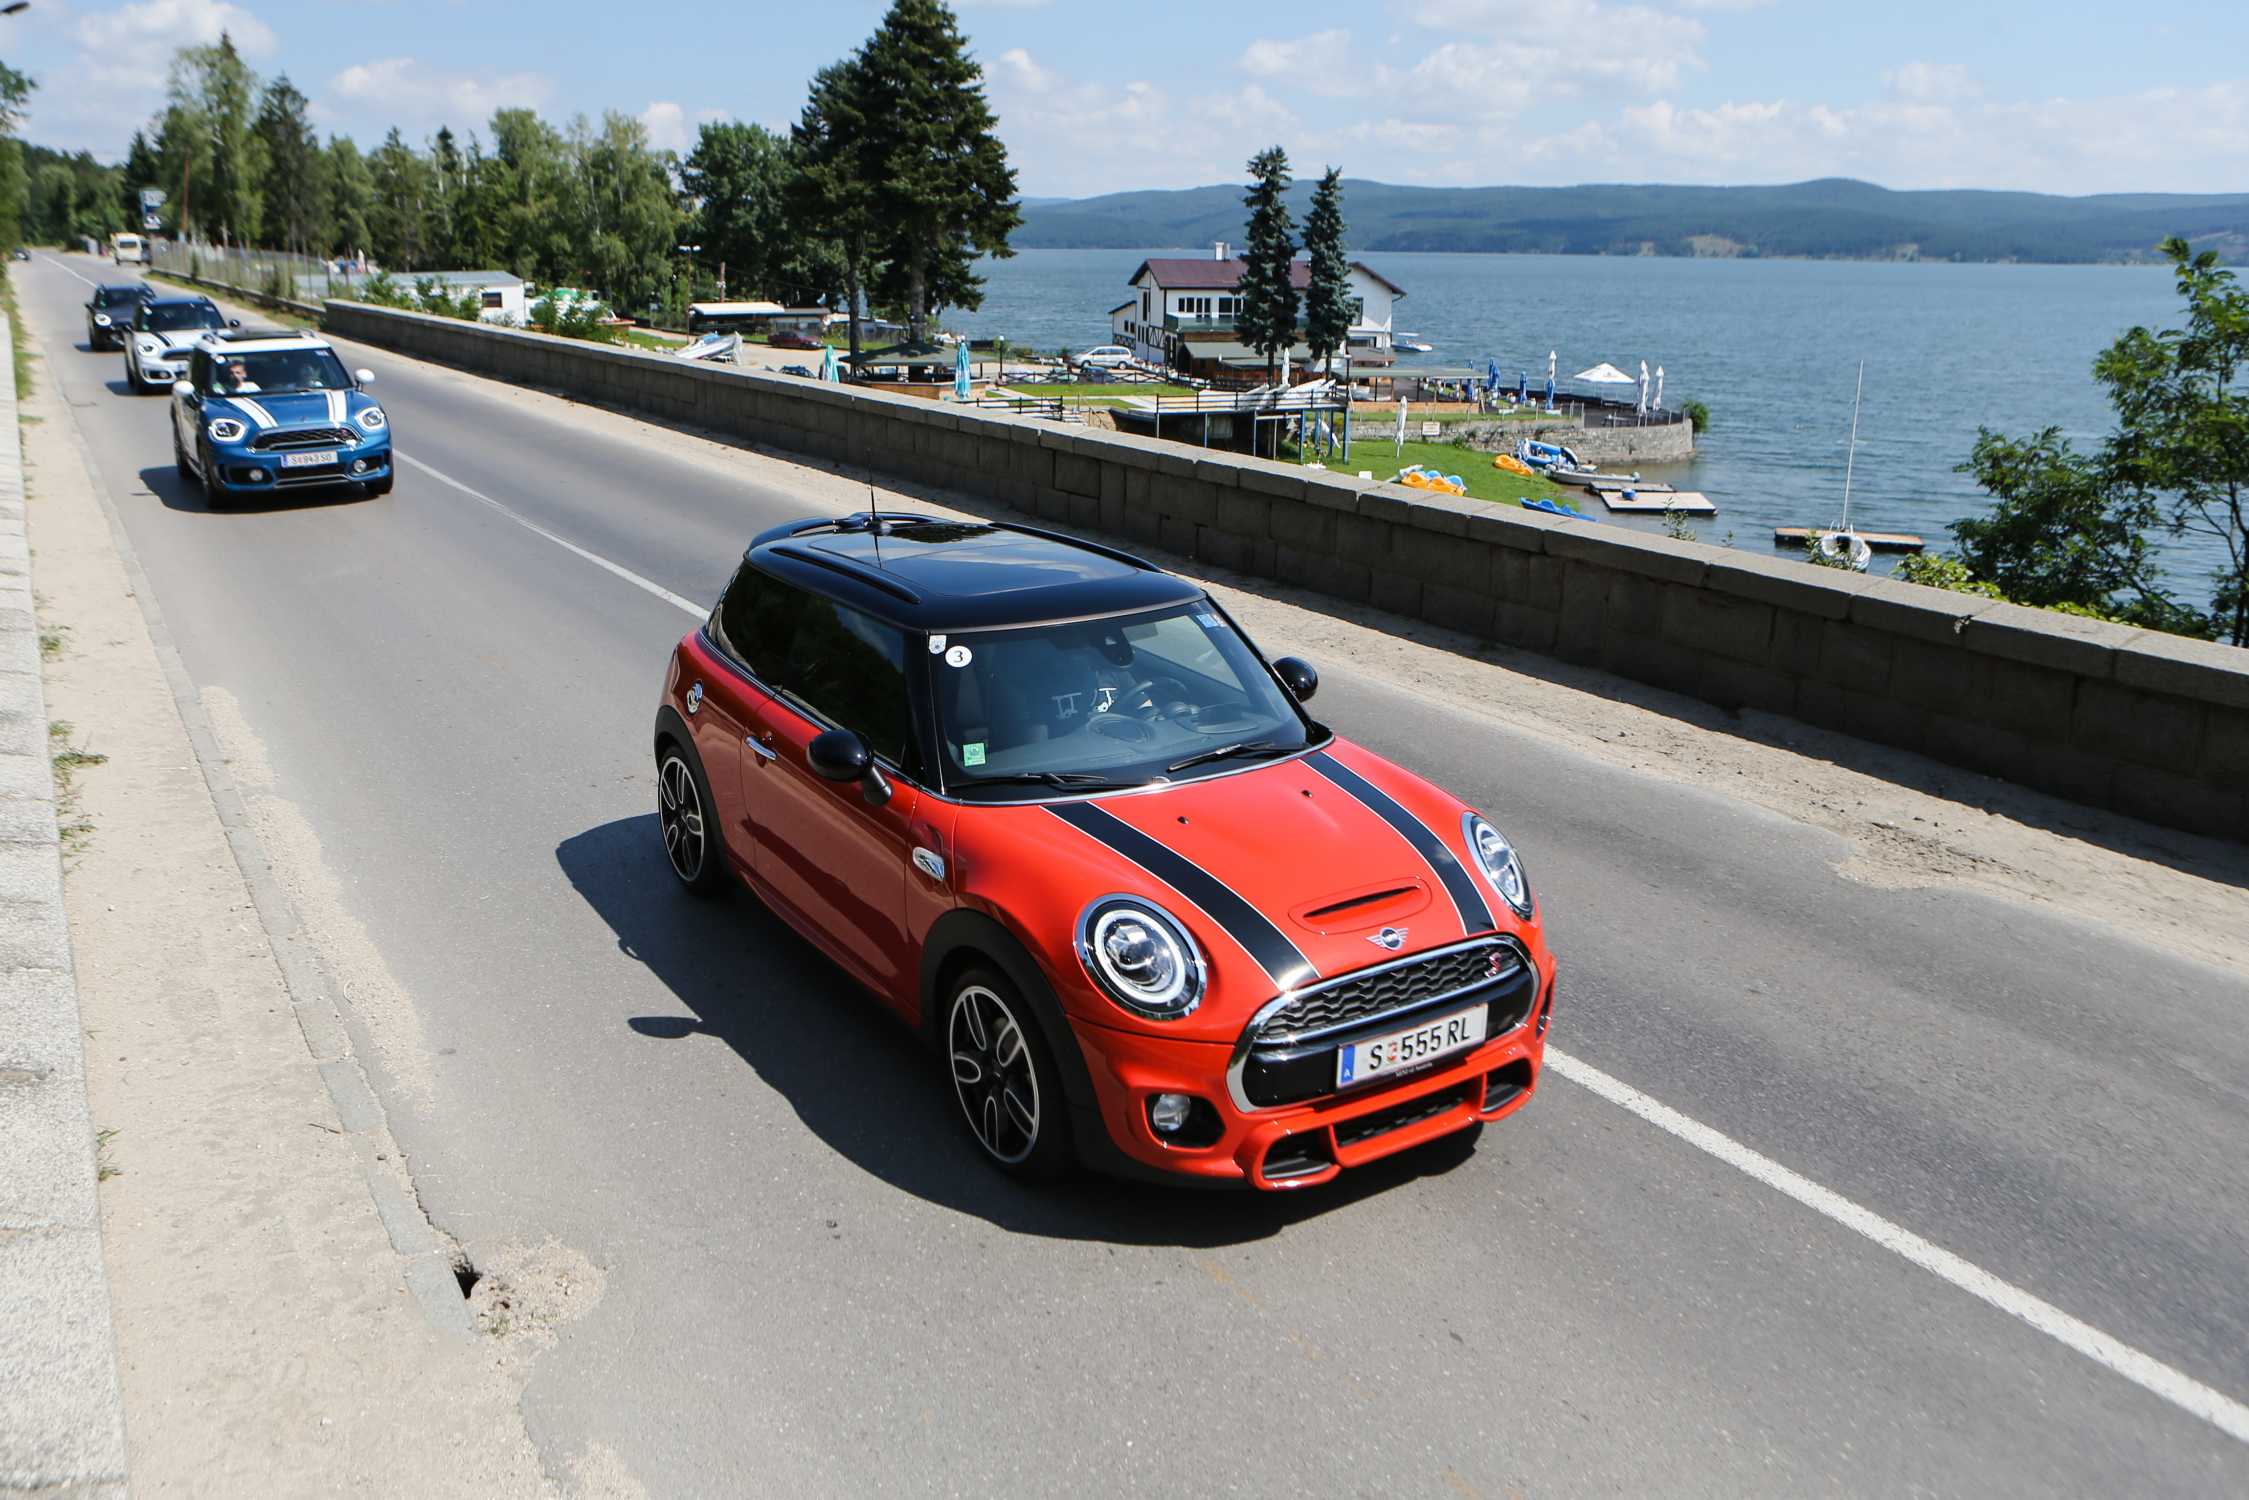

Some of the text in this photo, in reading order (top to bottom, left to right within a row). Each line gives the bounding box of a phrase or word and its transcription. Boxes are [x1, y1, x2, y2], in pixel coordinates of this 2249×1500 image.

[953, 650, 964, 663] 3
[1369, 1044, 1383, 1070] S
[1446, 1017, 1470, 1047] RL
